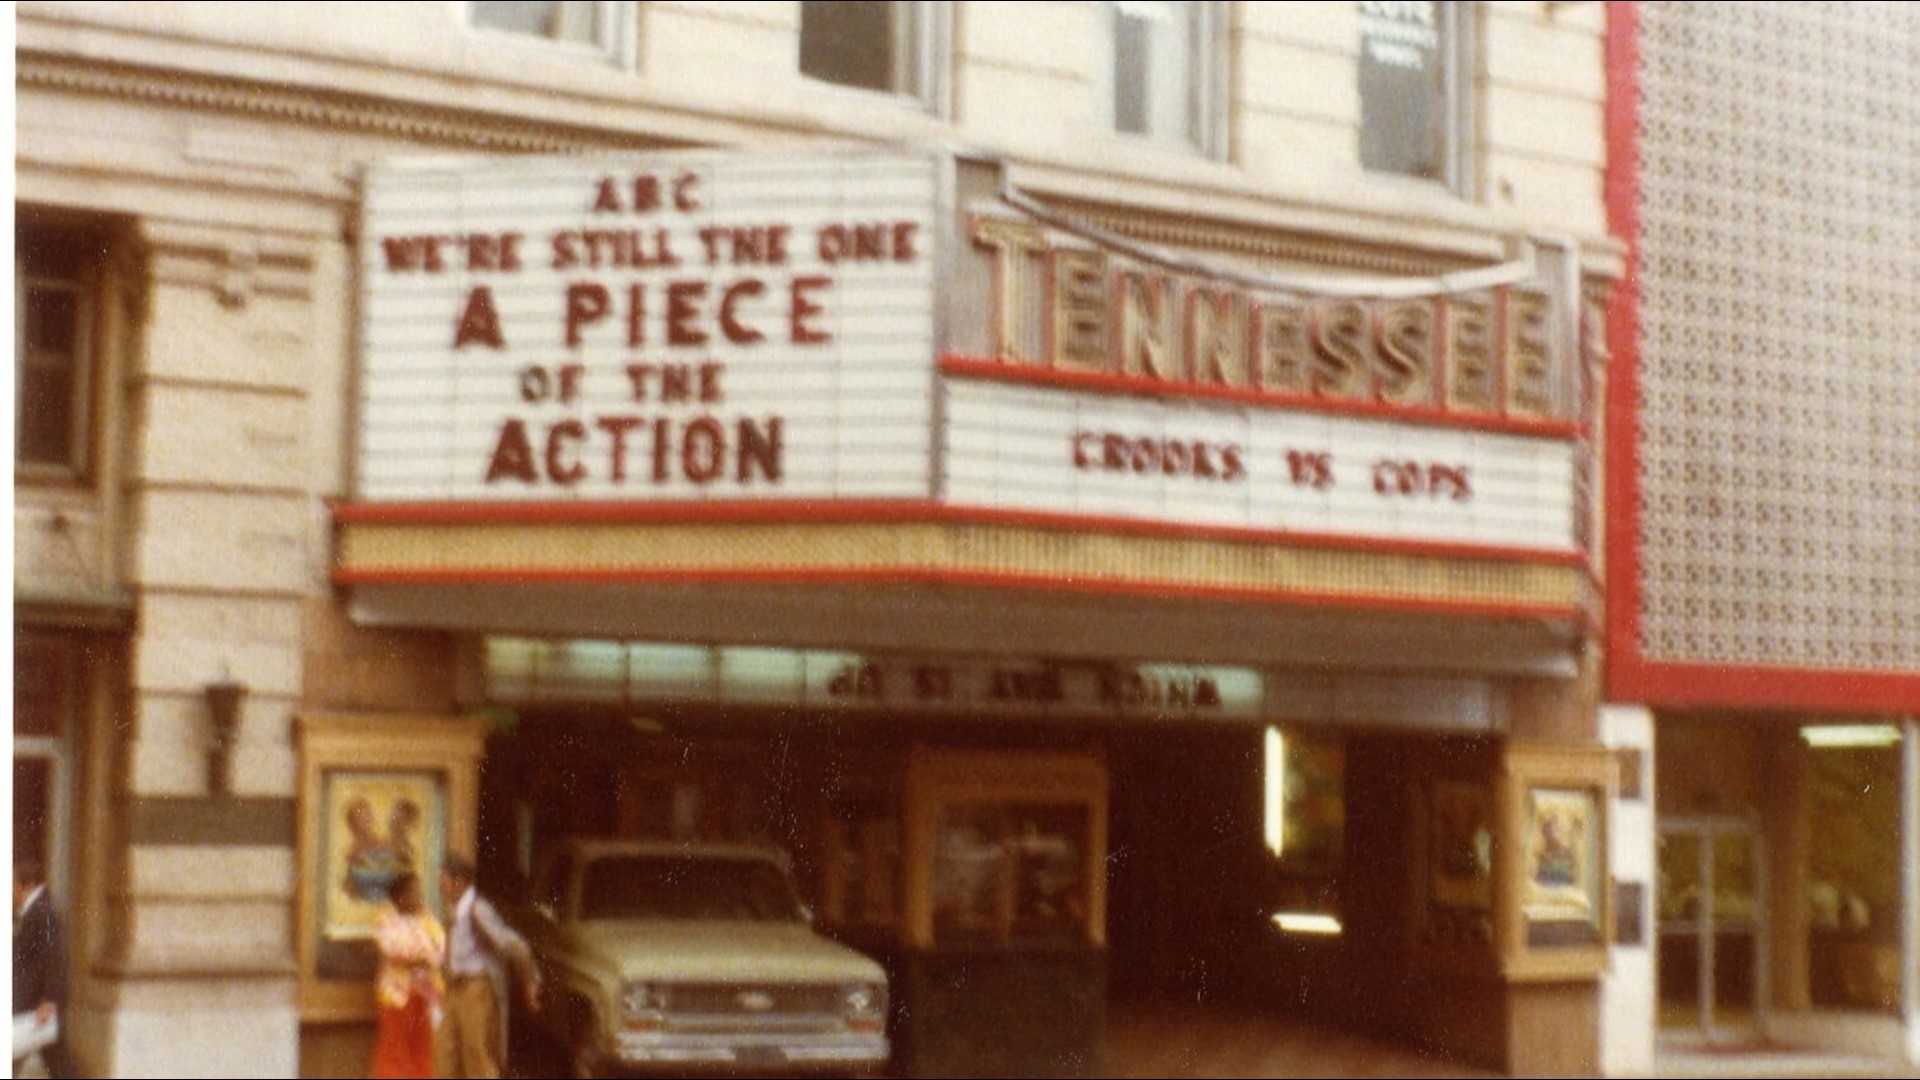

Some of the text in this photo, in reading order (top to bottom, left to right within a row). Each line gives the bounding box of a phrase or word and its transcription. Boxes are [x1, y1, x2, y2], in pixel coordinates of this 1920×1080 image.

[383, 222, 917, 272] WE'RE STILL THE ONE
[453, 276, 833, 349] A PIECE
[970, 216, 1552, 420] TENNESSEE
[519, 362, 724, 404] OF THE
[486, 417, 784, 485] ACTION
[1073, 431, 1474, 501] CROOKS VS COPS
